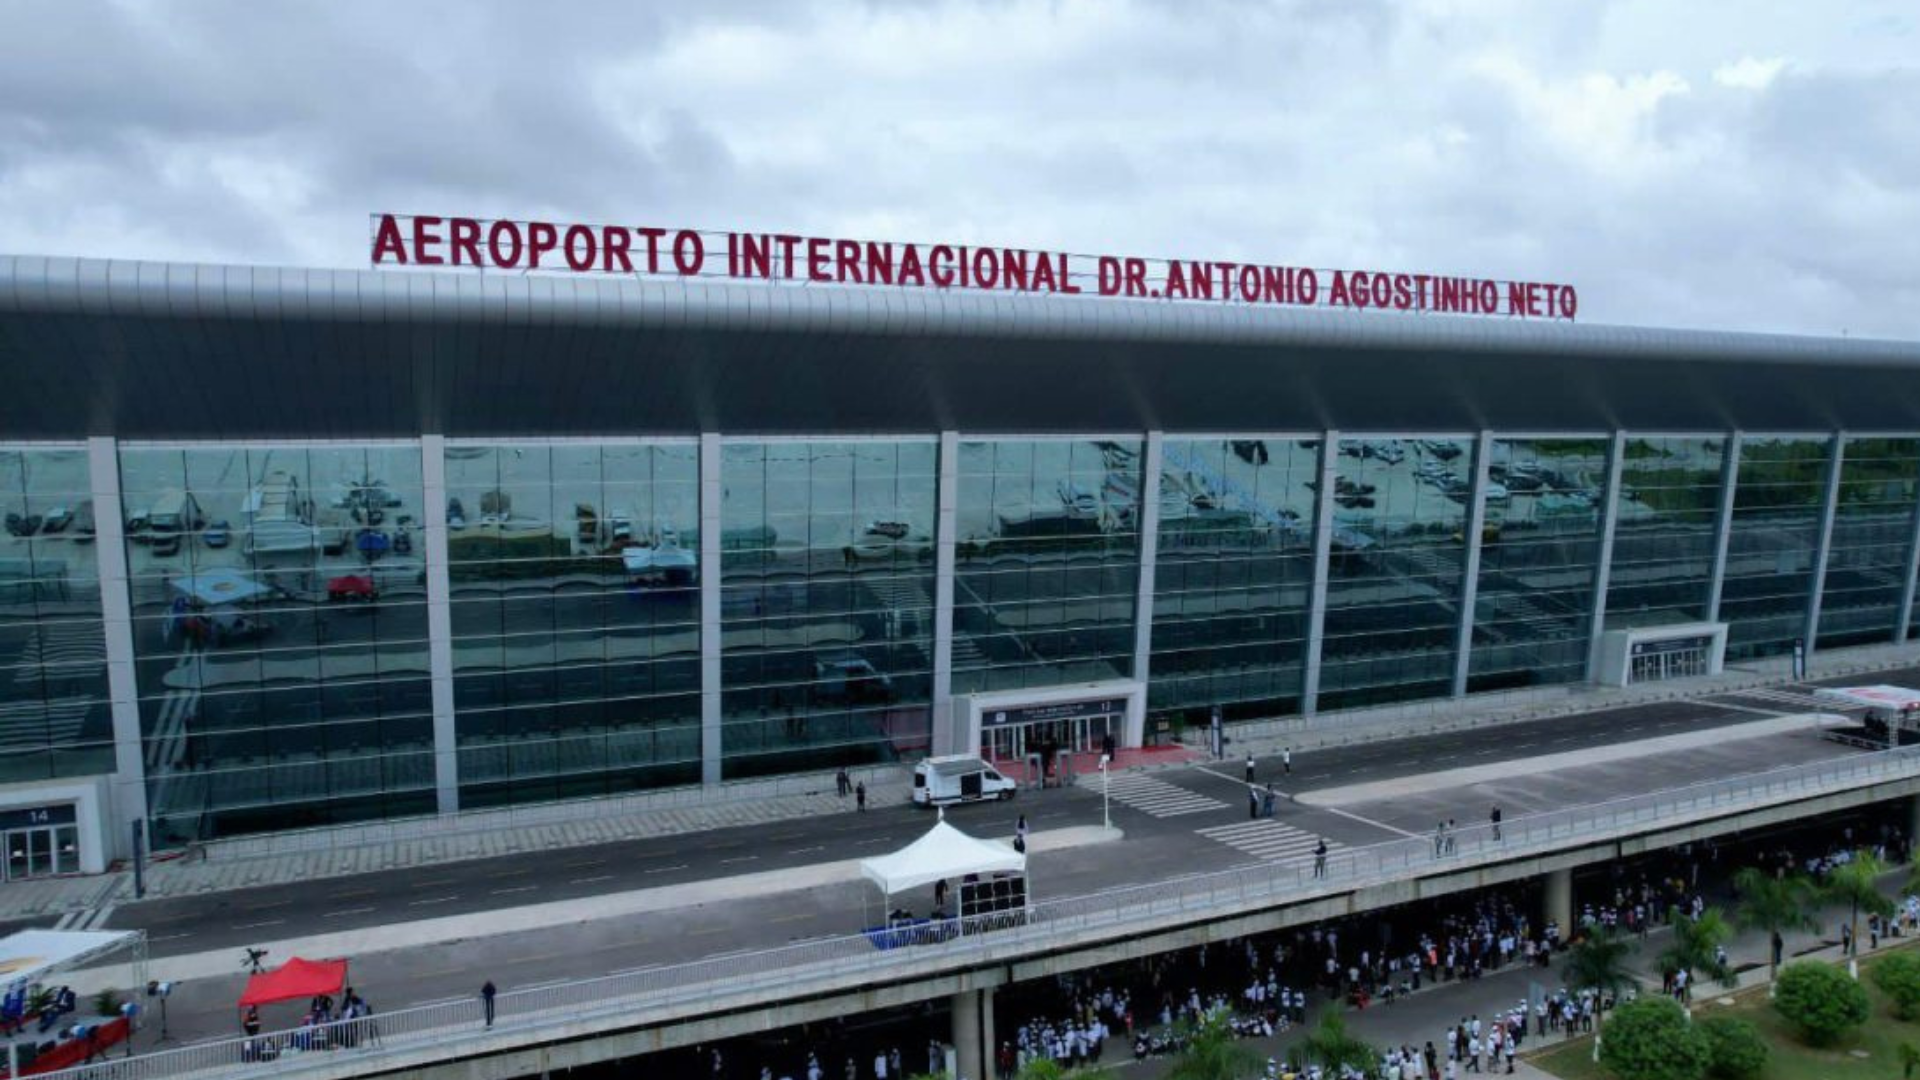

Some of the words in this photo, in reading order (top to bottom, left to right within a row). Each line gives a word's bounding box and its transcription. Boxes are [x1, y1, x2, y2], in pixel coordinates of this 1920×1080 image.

[372, 214, 704, 275] AEROPORTO
[728, 233, 1081, 295] INTERNACIONAL
[1329, 270, 1498, 315] AGOSTINHO
[1508, 282, 1577, 319] NETO
[30, 809, 49, 824] 14
